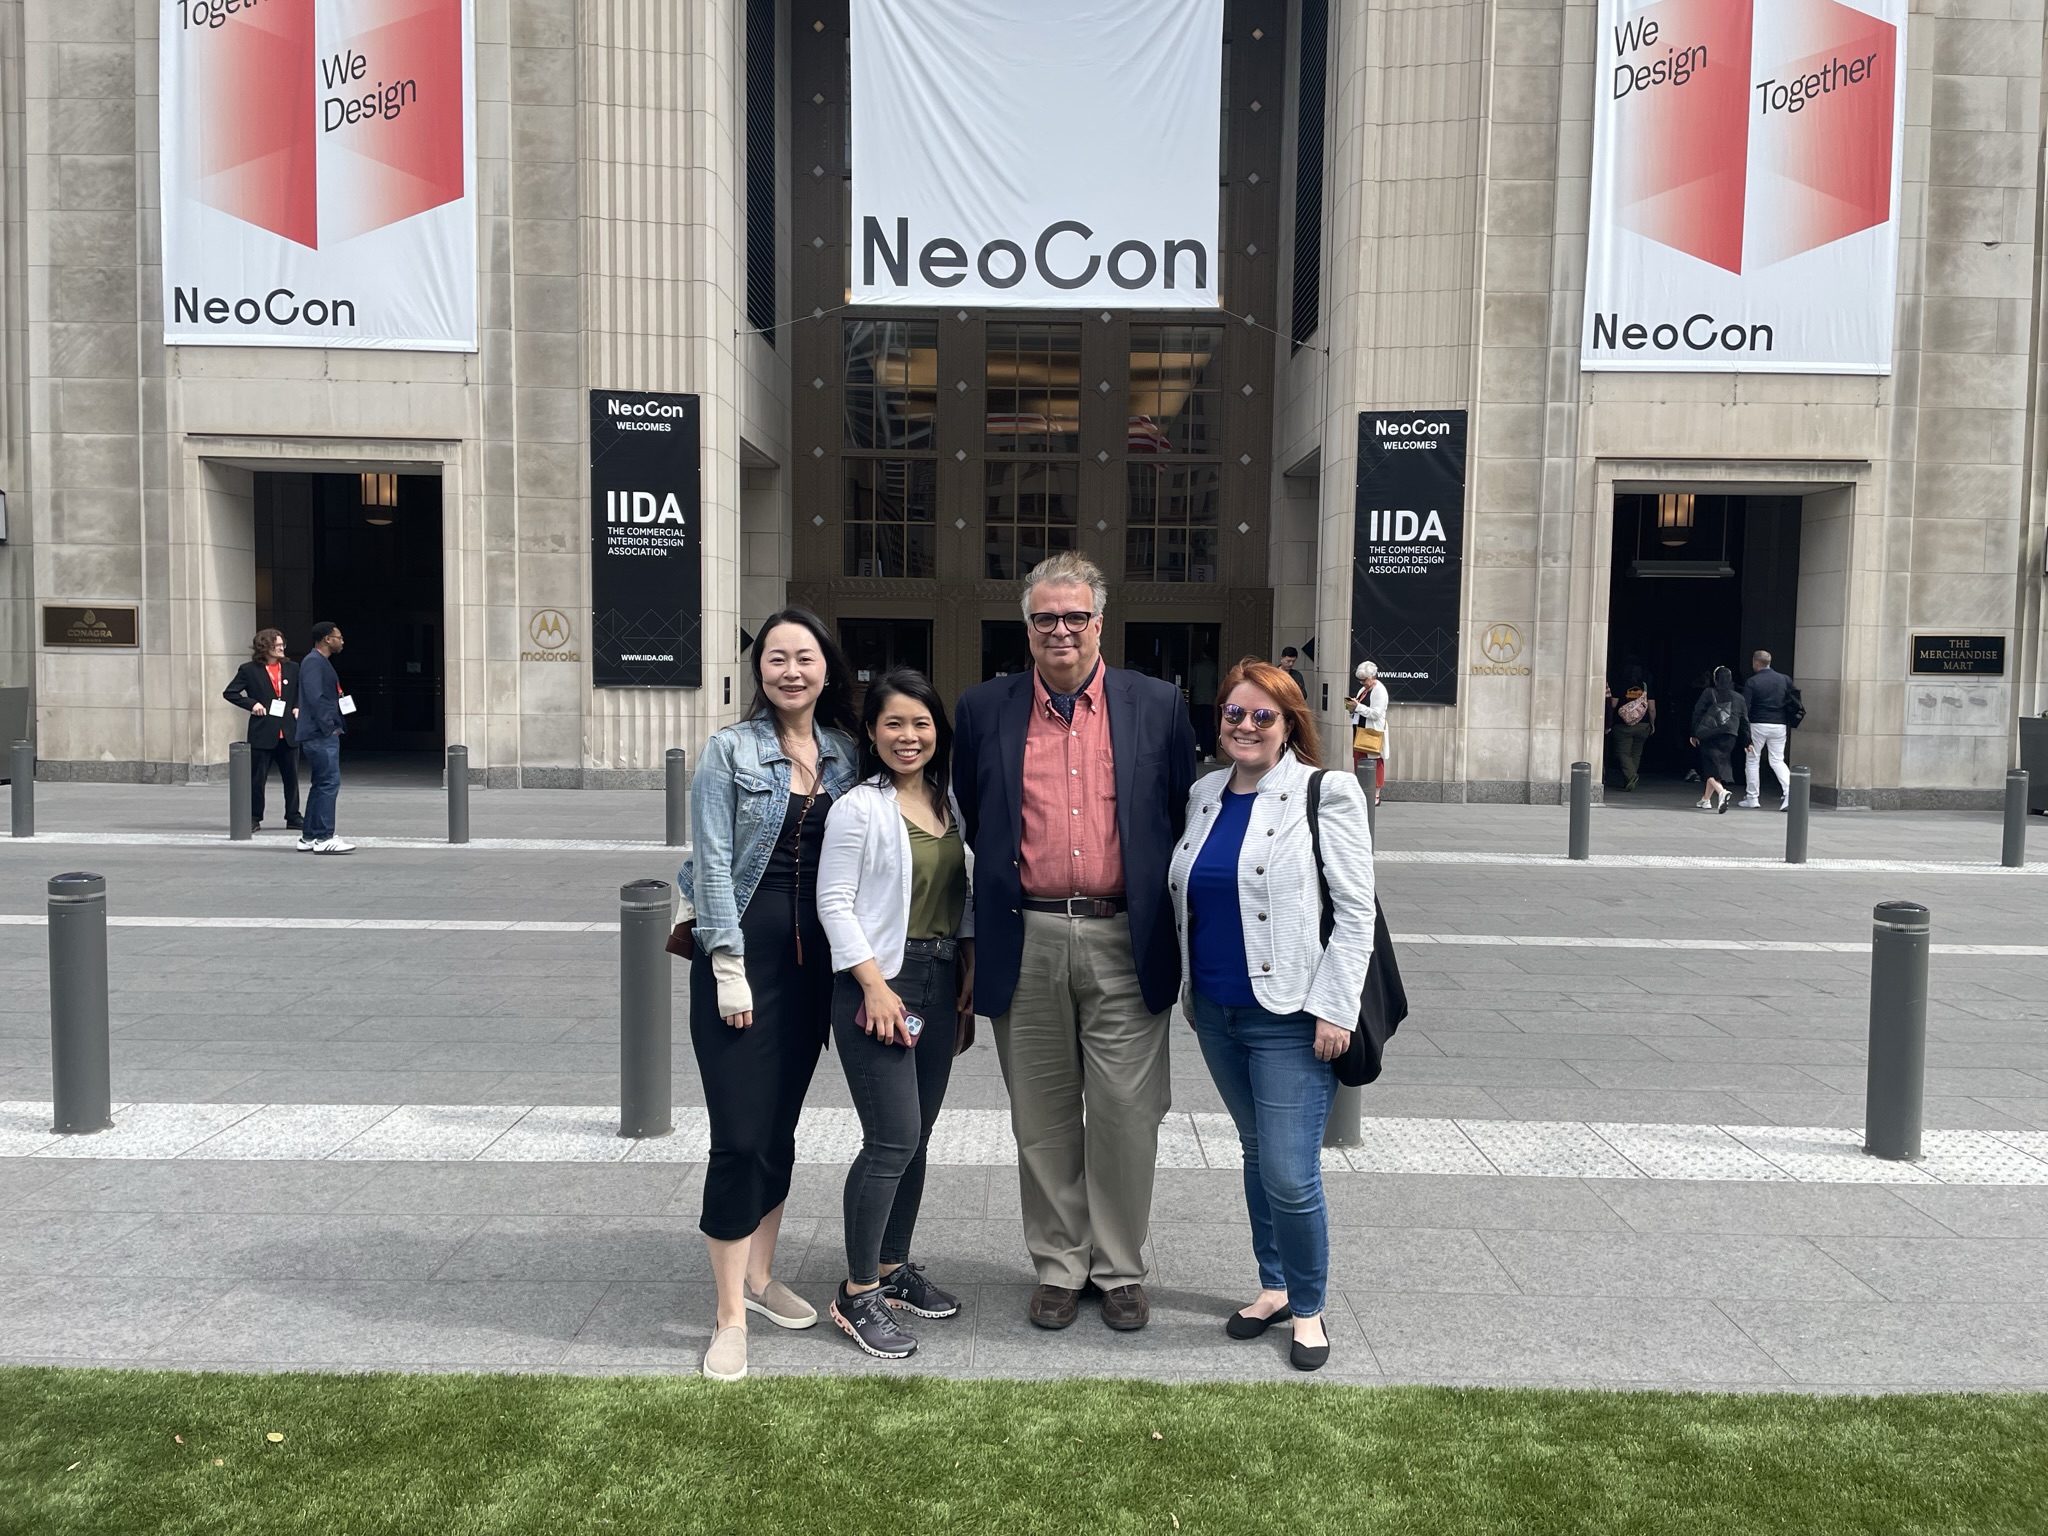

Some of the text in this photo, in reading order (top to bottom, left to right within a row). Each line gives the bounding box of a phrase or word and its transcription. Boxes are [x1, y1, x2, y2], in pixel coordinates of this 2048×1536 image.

[1614, 16, 1659, 57] We
[322, 49, 367, 90] We
[1613, 45, 1707, 101] Design
[1756, 53, 1877, 115] Together
[324, 79, 417, 133] Design
[863, 215, 1207, 290] NeoCon
[174, 286, 355, 327] NeoCon
[1592, 312, 1773, 351] NeoCon
[607, 399, 684, 418] NeoCon
[616, 421, 672, 432] WELCOMES
[1375, 419, 1450, 436] NeoCon
[1383, 441, 1438, 450] WELCOMES
[607, 490, 686, 525] IIDA
[607, 526, 686, 537] THE COMMERCIAL
[1369, 510, 1447, 542] IIDA
[607, 536, 684, 547] INTERIOR DESIGN
[607, 547, 668, 557] ASSOCIATION
[1369, 545, 1447, 554] THE COMMERCIAL
[1369, 555, 1445, 564] INTERIOR DESIGN
[1368, 565, 1428, 574] ASSOCIATION
[67, 629, 113, 638] CONAGRA
[1949, 640, 1971, 649] THE
[521, 650, 580, 662] motorola
[621, 654, 674, 662] WWW.IIDA.ORG
[1919, 650, 1998, 660] MERCHANDISE
[1472, 664, 1532, 676] motorola
[1943, 661, 1974, 670] MART
[1377, 671, 1429, 679] WWW.IIDA.ORG
